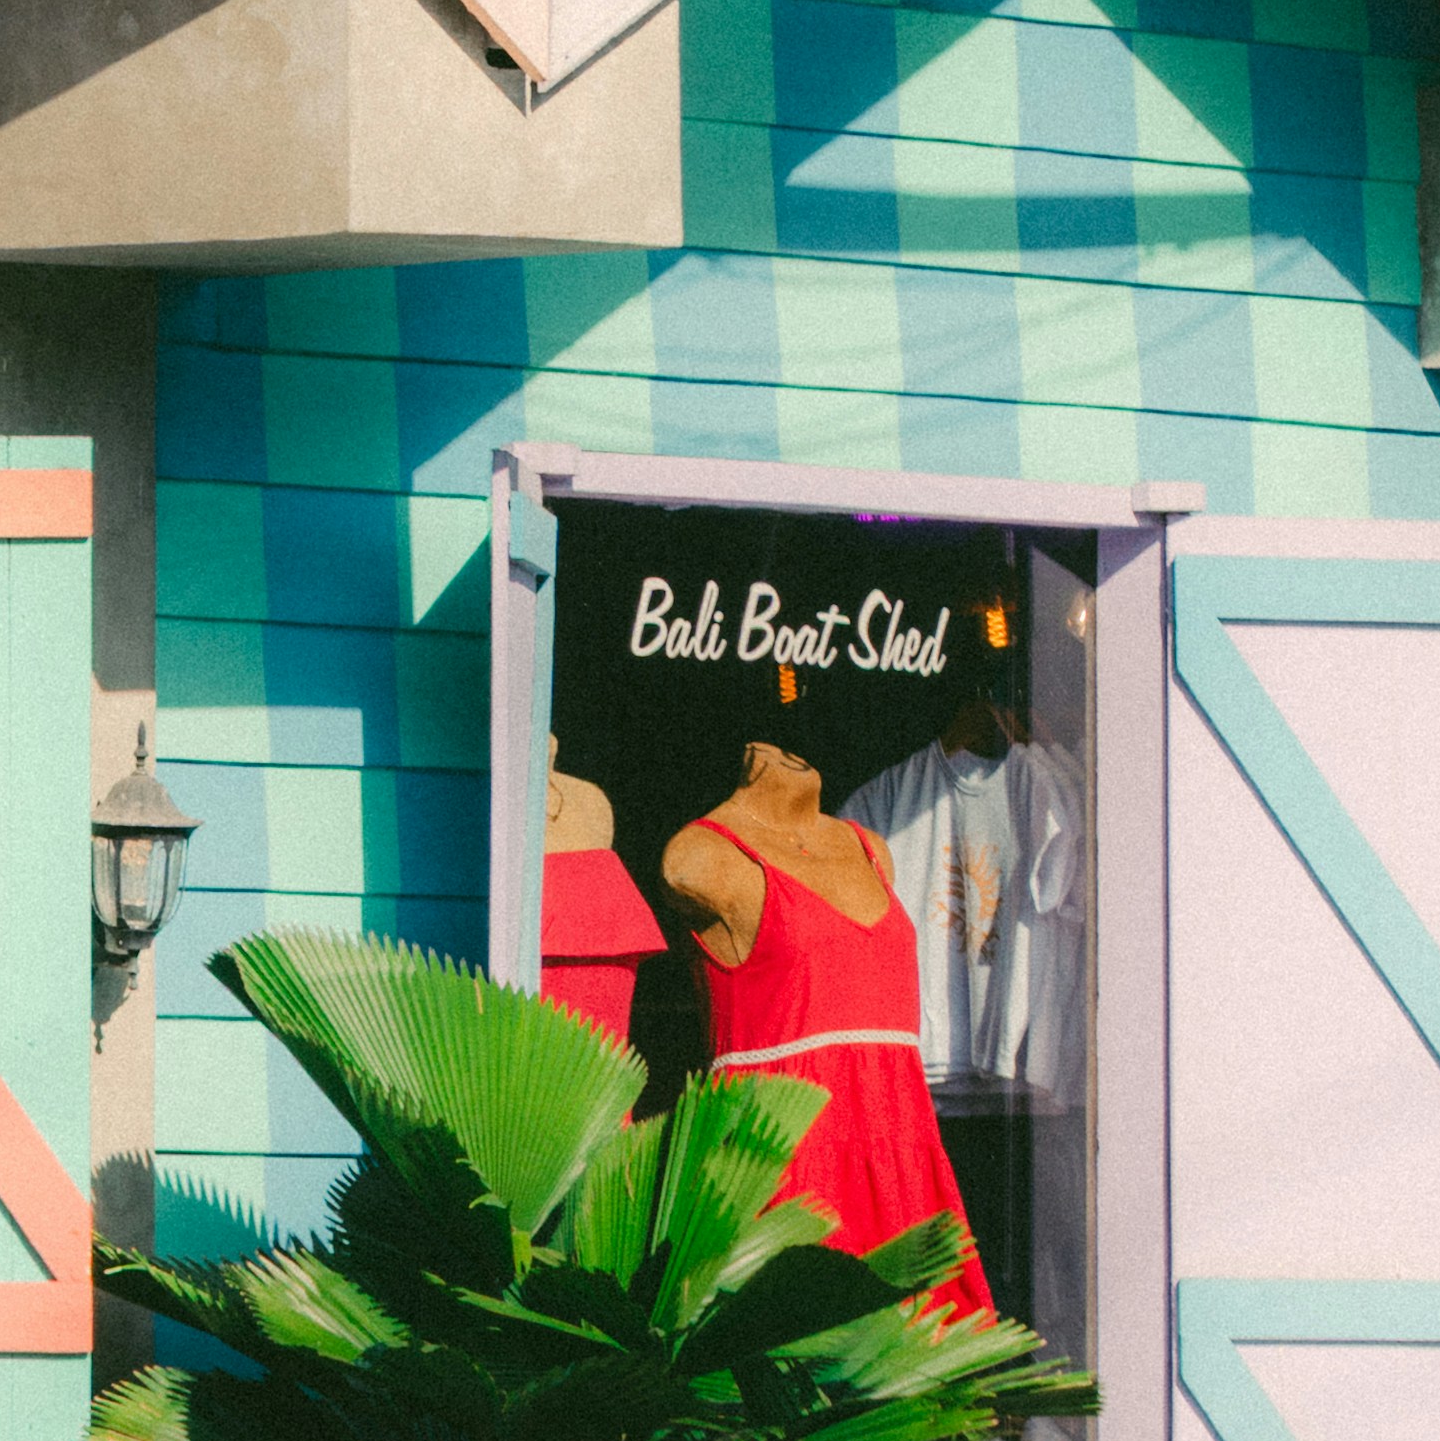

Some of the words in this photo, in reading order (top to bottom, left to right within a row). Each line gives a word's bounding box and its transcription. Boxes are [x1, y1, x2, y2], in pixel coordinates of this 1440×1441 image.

[631, 577, 727, 661] Bali
[737, 582, 851, 668] Boat
[848, 589, 950, 677] Shed
